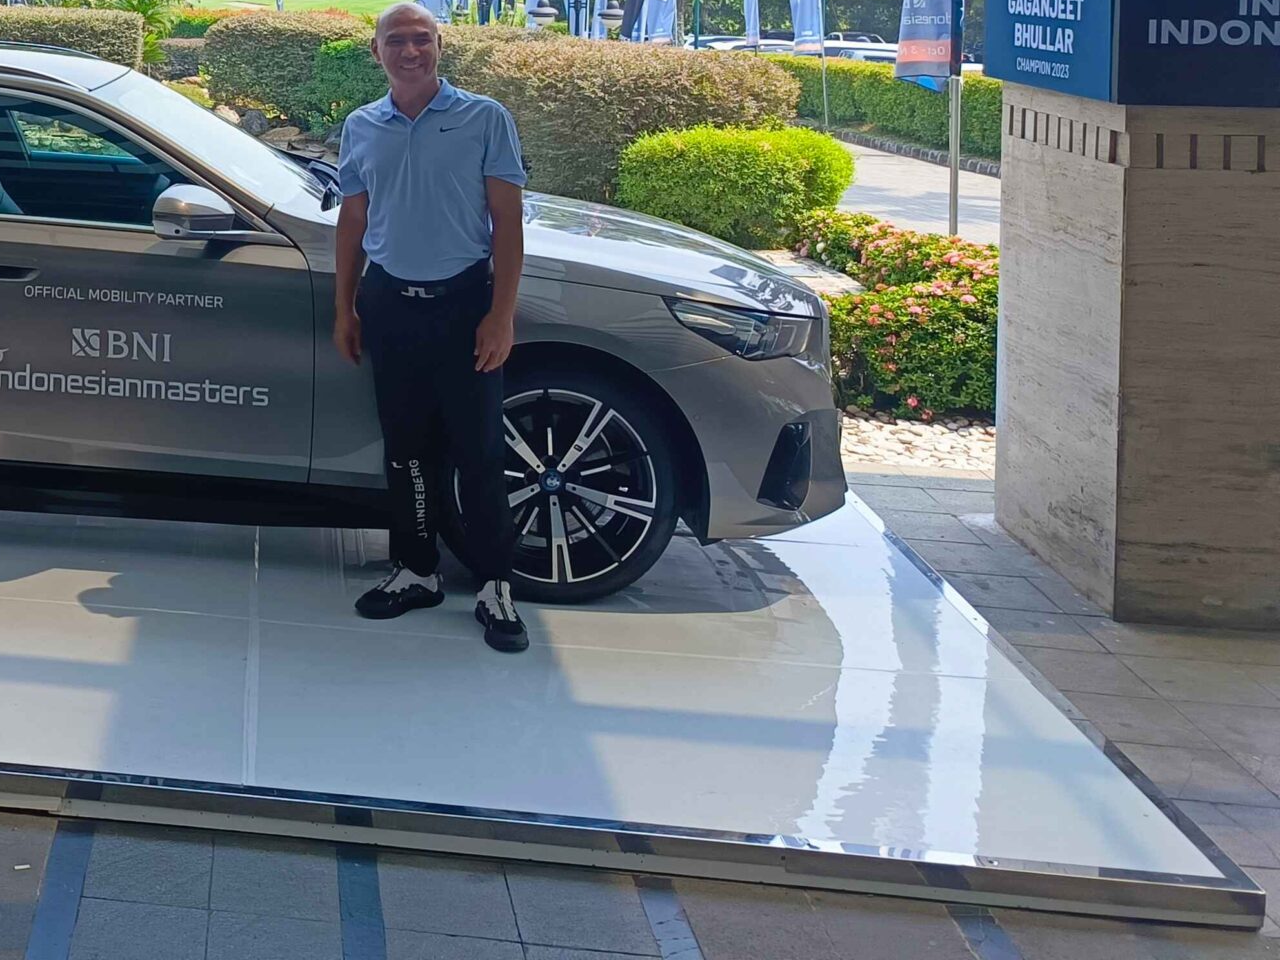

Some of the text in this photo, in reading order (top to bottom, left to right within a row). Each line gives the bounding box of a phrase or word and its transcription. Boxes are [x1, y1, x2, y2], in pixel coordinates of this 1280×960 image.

[1014, 23, 1074, 55] BHULLAR
[1016, 56, 1070, 79] CHAMPION 2023
[24, 285, 224, 309] OFFICIAL MOBILITY PARTNER
[106, 330, 173, 363] BNI
[409, 459, 428, 539] J.LINDEBERG
